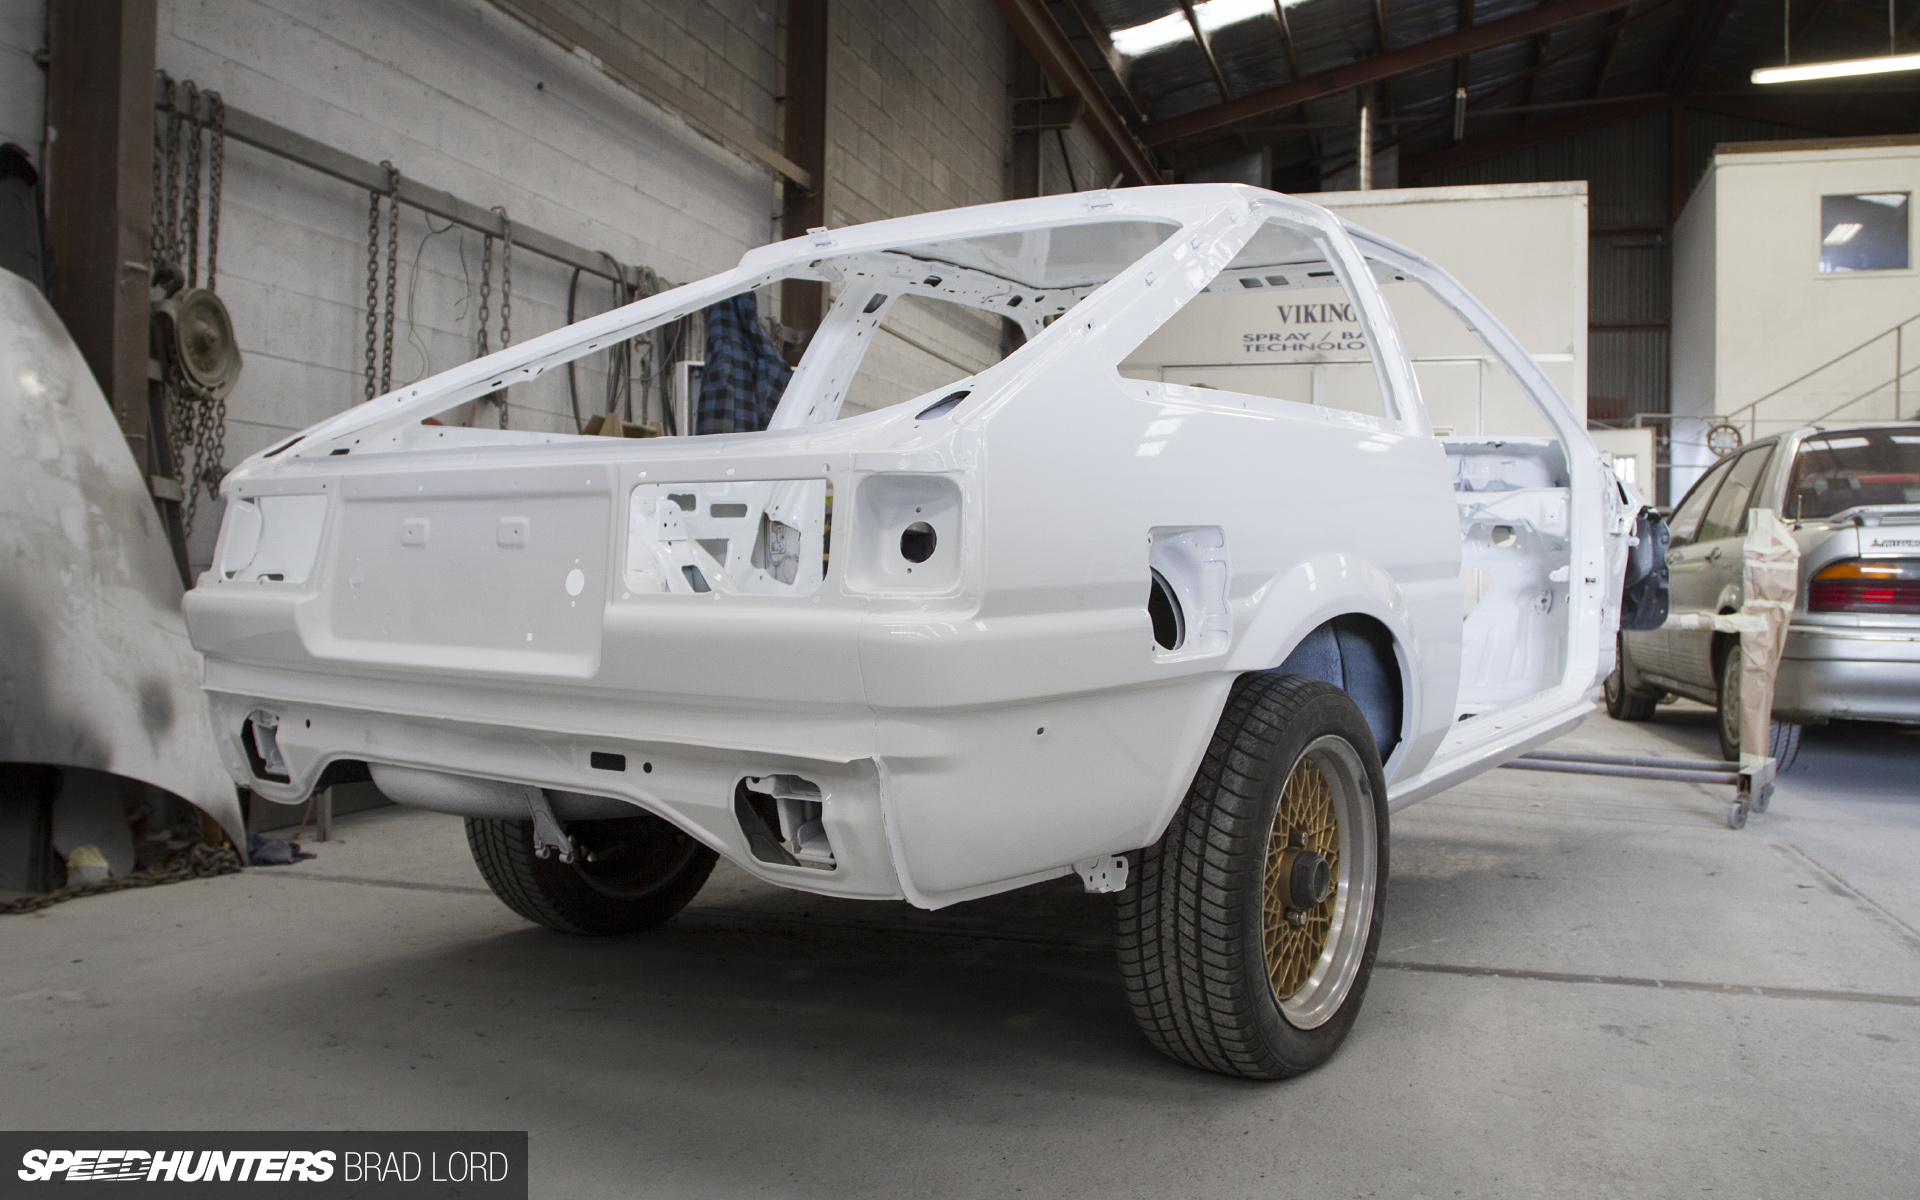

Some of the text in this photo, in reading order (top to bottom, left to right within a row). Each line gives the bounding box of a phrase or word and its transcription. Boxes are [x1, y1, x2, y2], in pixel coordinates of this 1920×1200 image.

[1277, 303, 1357, 324] VIKING
[1243, 332, 1311, 342] SPRAY
[1321, 331, 1332, 341] /
